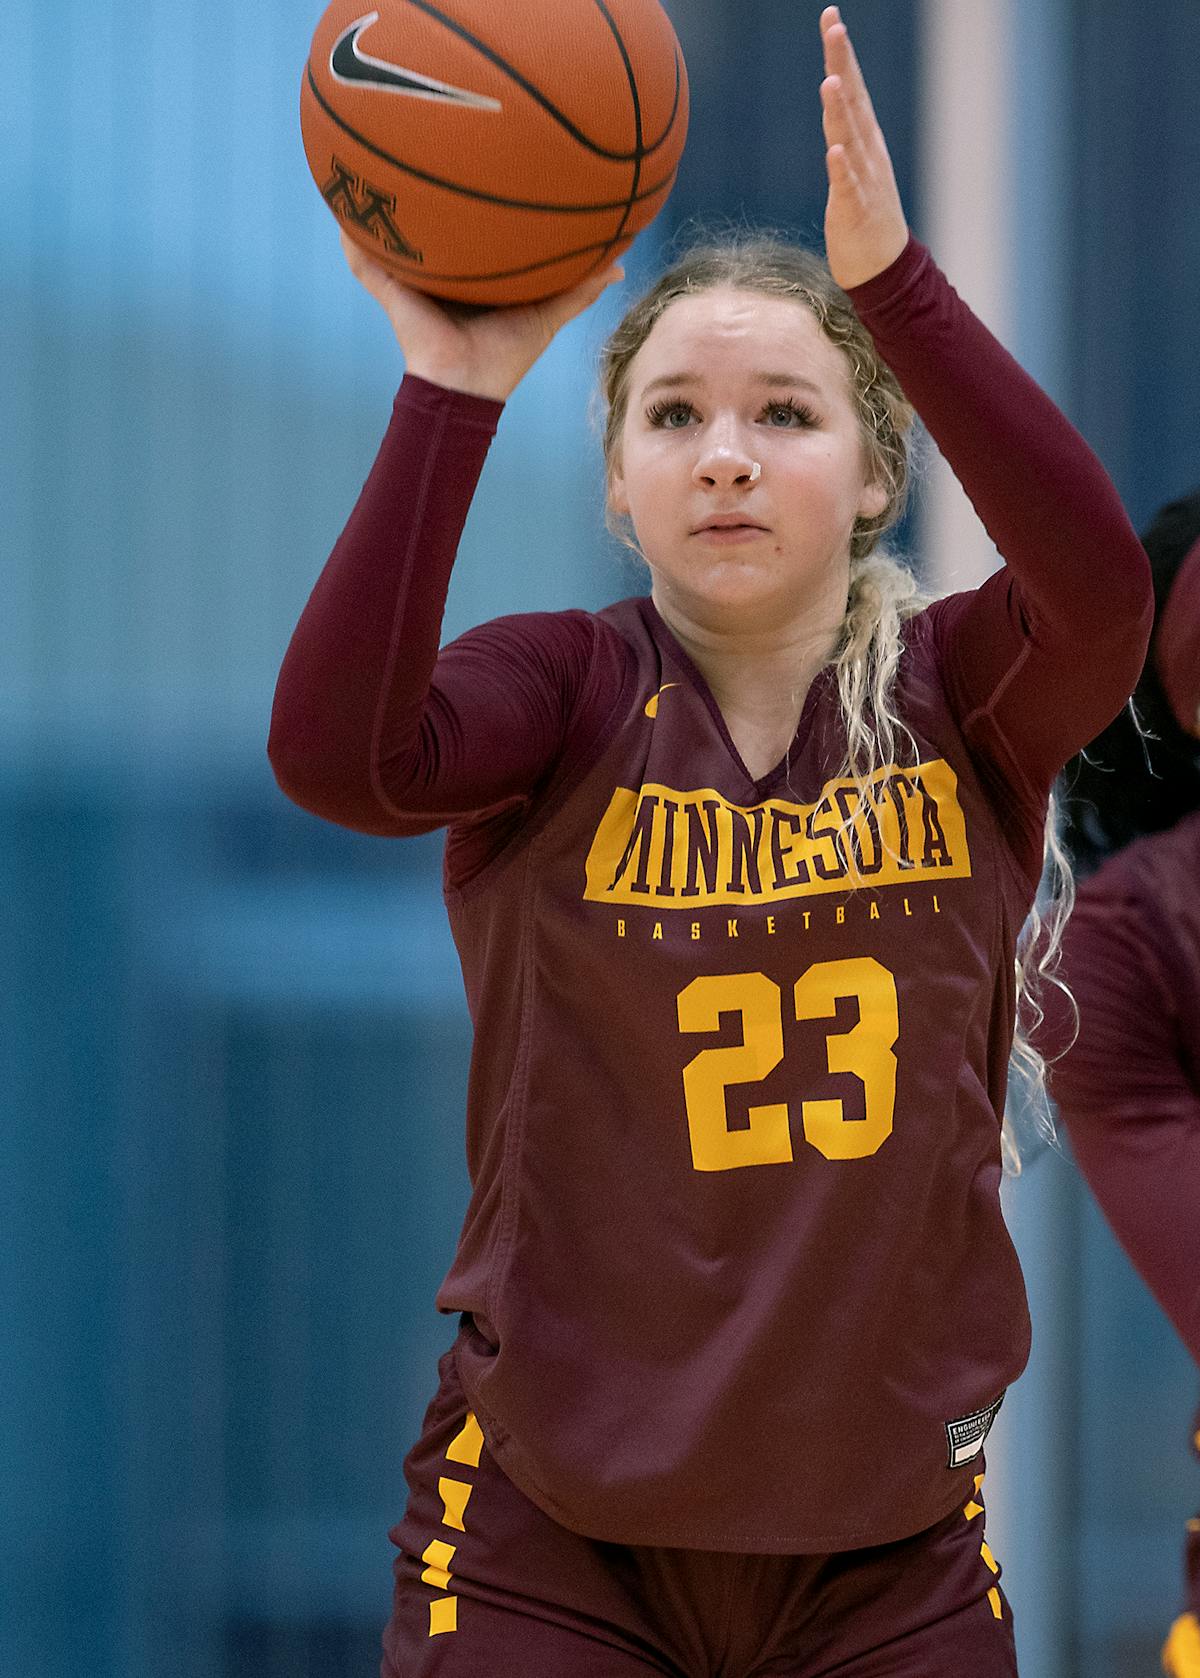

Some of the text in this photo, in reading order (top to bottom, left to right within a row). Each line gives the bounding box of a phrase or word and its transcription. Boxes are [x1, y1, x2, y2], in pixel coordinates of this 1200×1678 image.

[605, 773, 953, 897] MINNESOTA
[616, 894, 940, 940] BASKETBALL
[677, 956, 899, 1172] 23
